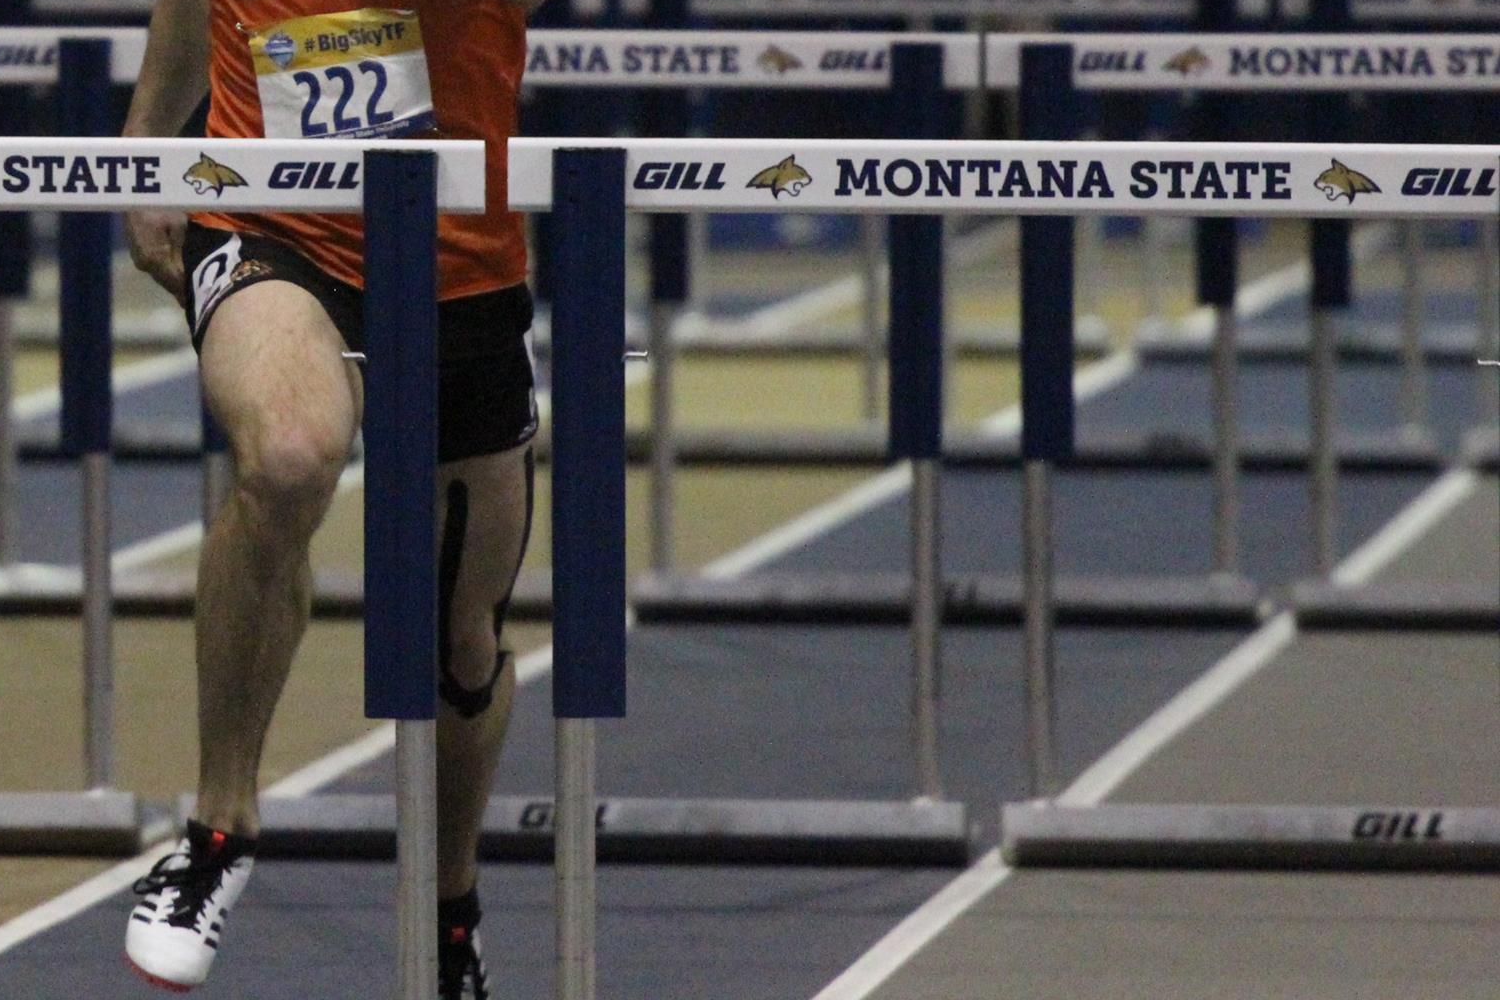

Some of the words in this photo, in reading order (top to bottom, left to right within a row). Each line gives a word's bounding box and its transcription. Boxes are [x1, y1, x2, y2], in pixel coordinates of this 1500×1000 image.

[304, 22, 405, 52] #BigSkyTF
[622, 45, 740, 74] STATE
[1079, 51, 1147, 73] GILL
[1229, 48, 1435, 76] MONTANA
[293, 60, 395, 137] 222
[2, 154, 161, 194] STATE
[267, 161, 360, 190] GILL
[632, 161, 726, 191] GILL
[834, 157, 1115, 199] MONTANA
[1129, 160, 1292, 200] STATE
[1400, 167, 1497, 197] GILL
[1354, 811, 1443, 838] GILL
